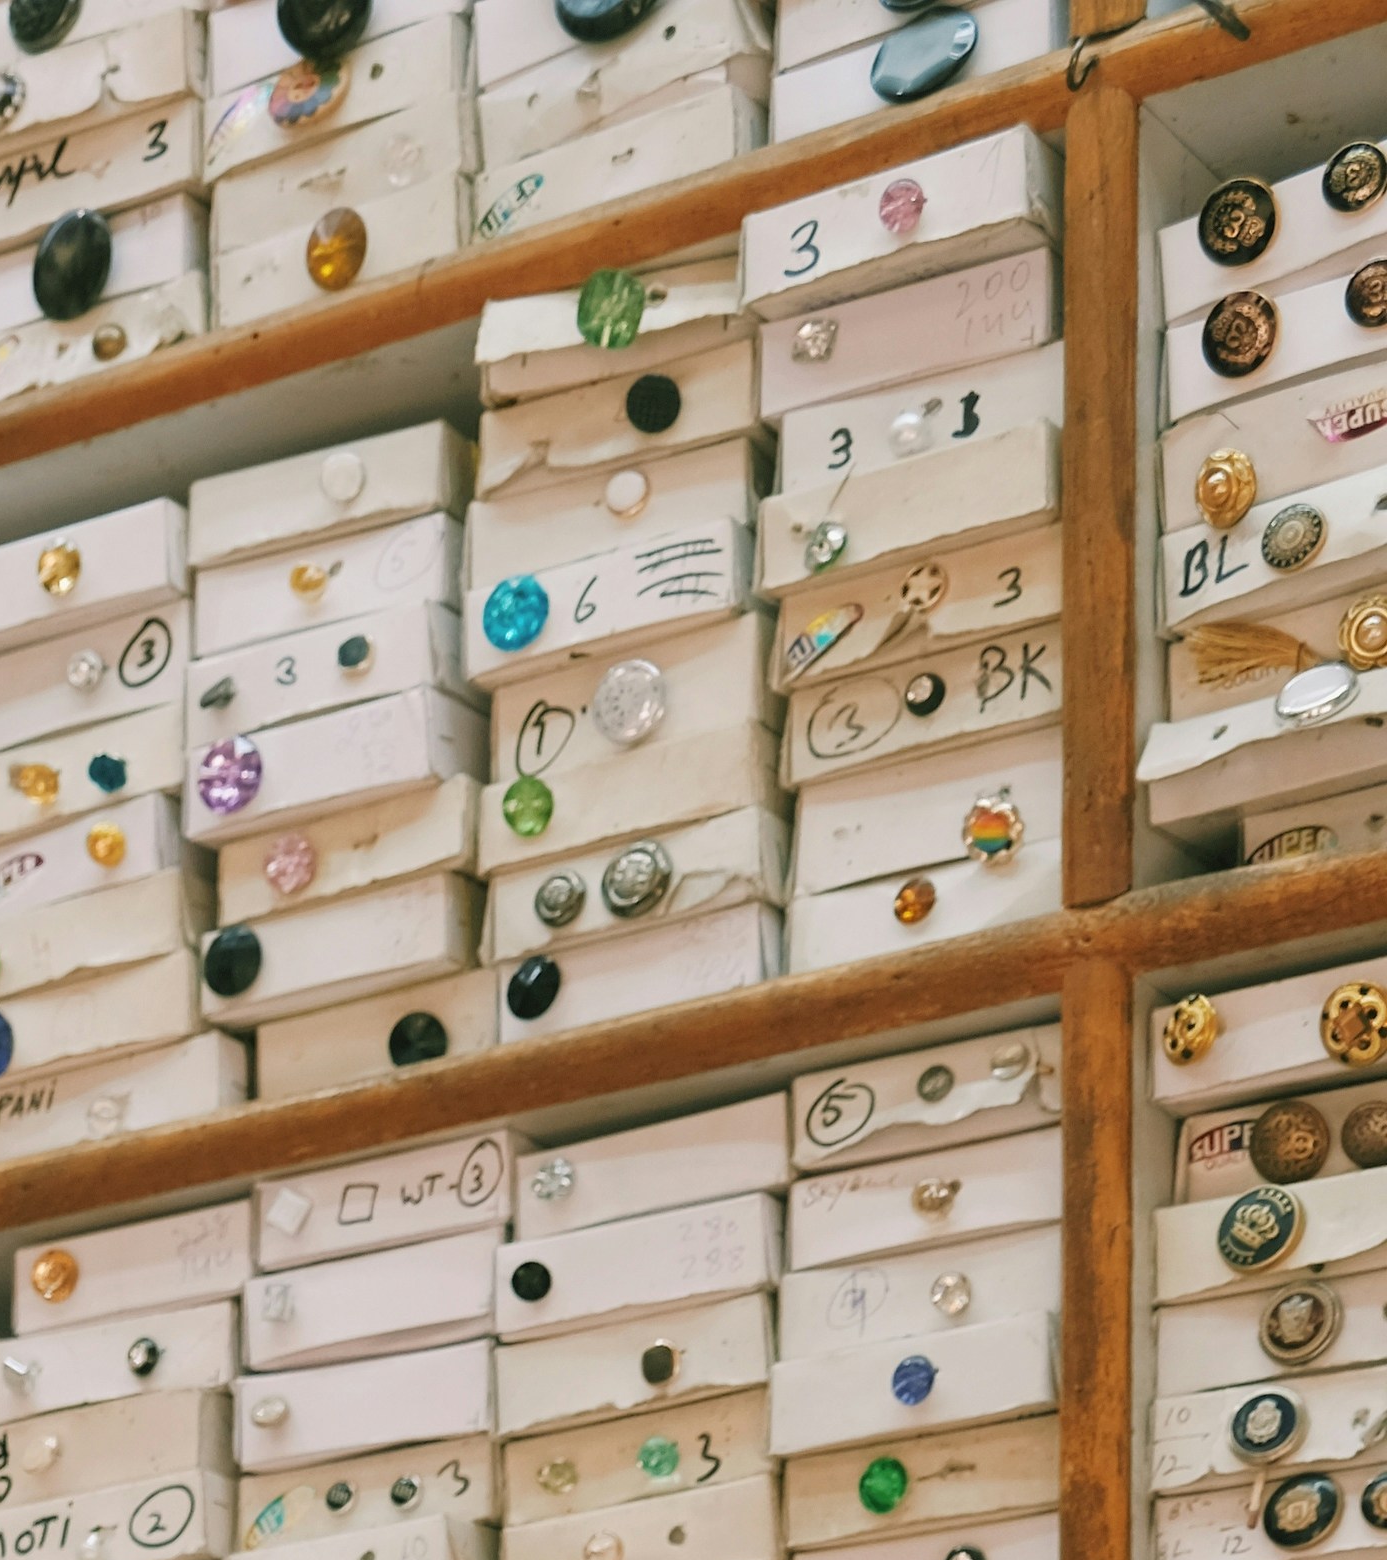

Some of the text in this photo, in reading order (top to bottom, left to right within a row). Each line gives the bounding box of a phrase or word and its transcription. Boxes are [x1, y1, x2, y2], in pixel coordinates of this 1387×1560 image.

[142, 120, 168, 162] 3
[782, 219, 821, 278] 3
[827, 426, 853, 471] 3
[991, 566, 1025, 608] 3
[1179, 535, 1249, 597] BL
[573, 575, 598, 627] 6
[275, 657, 298, 687] 3
[695, 1433, 722, 1483] 3
